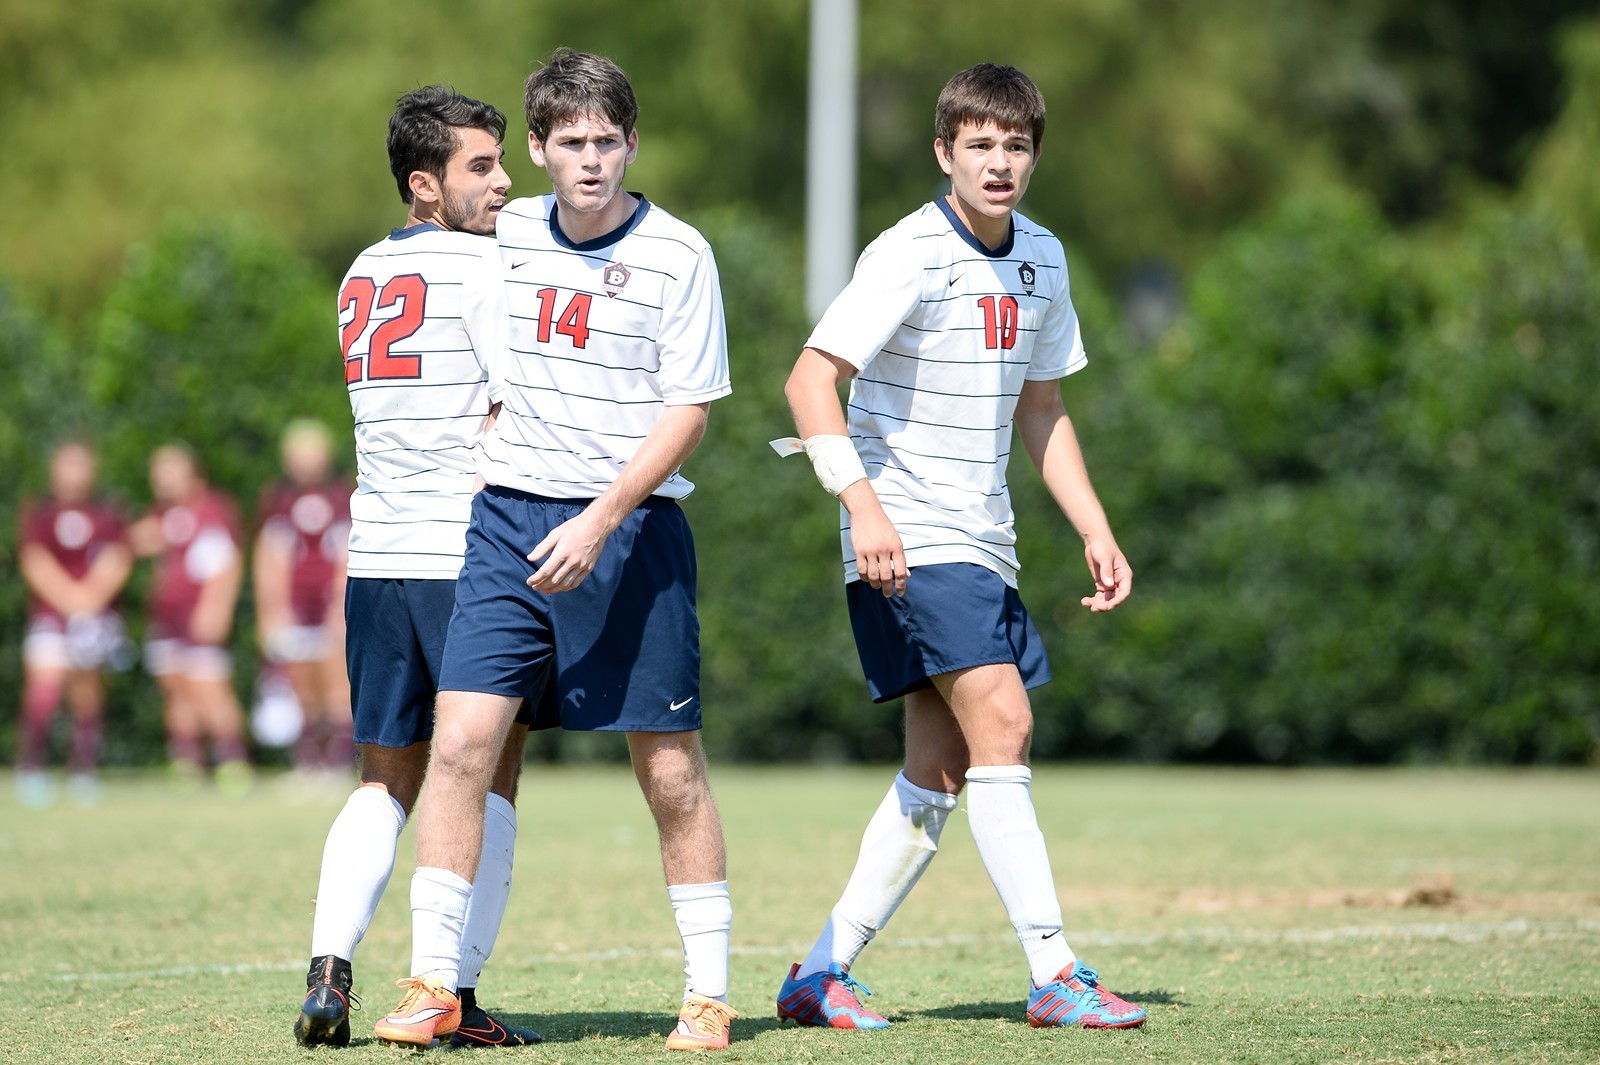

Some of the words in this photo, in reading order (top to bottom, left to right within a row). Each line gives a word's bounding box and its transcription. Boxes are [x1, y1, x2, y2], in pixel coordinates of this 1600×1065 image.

[339, 273, 428, 386] 22
[536, 288, 593, 350] 14
[977, 295, 1018, 350] 10
